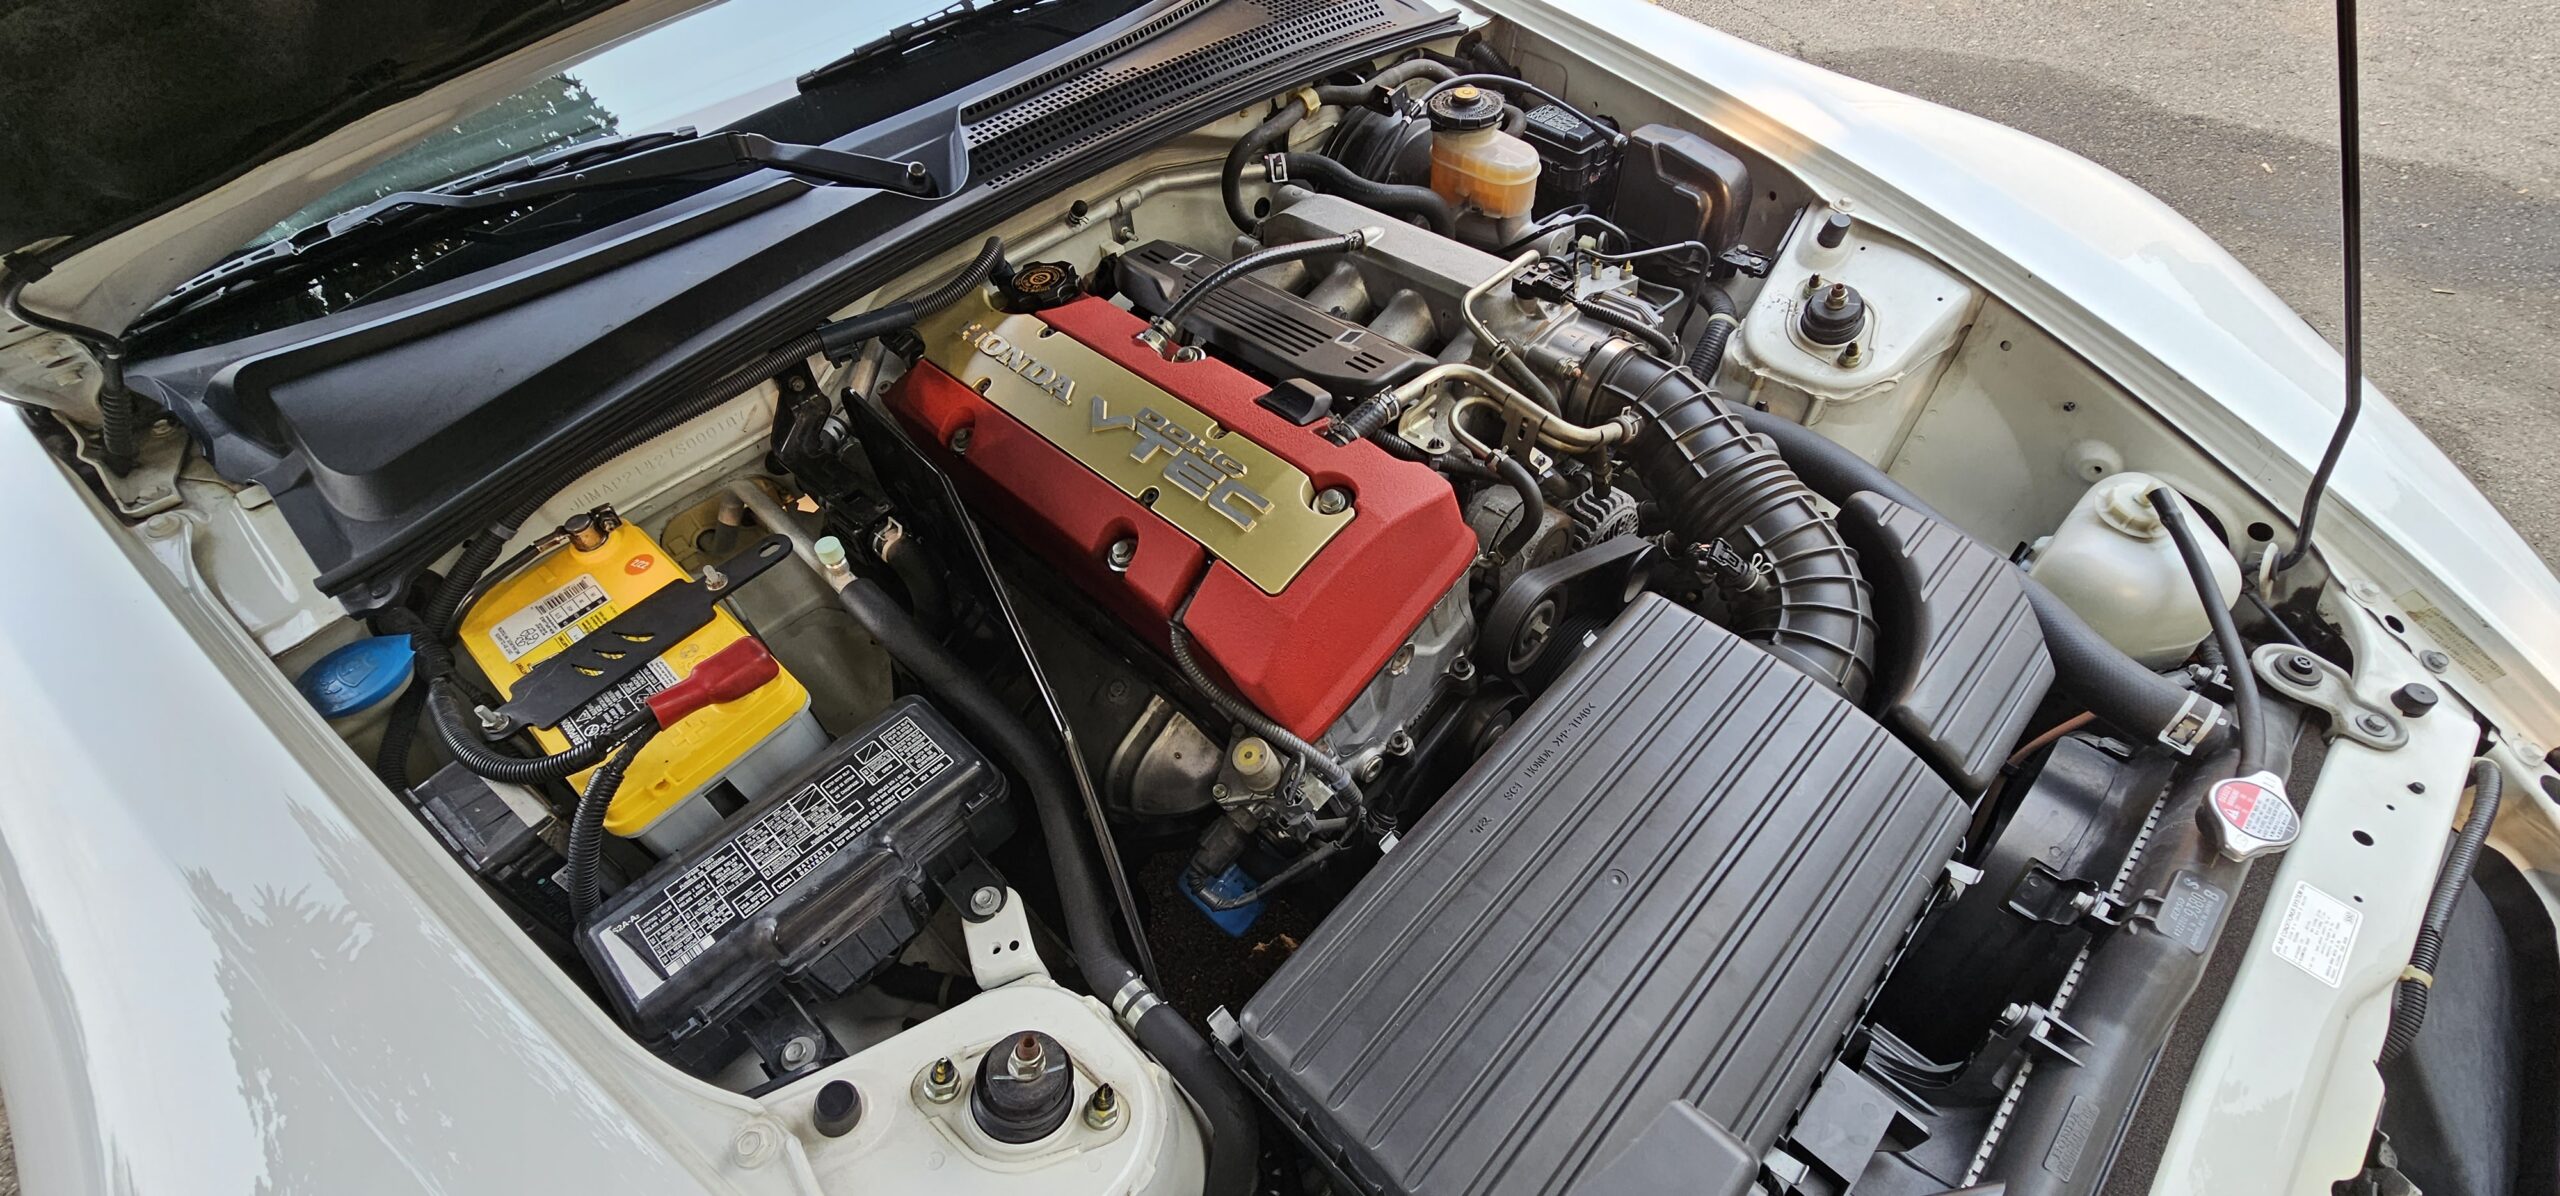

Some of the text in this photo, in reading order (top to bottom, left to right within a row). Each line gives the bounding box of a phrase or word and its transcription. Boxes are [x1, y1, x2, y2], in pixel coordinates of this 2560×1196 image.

[957, 320, 1076, 406] HONDA
[1091, 394, 1276, 534] VTEC
[1134, 406, 1249, 480] DOHC
[795, 847, 827, 872] BATTERY
